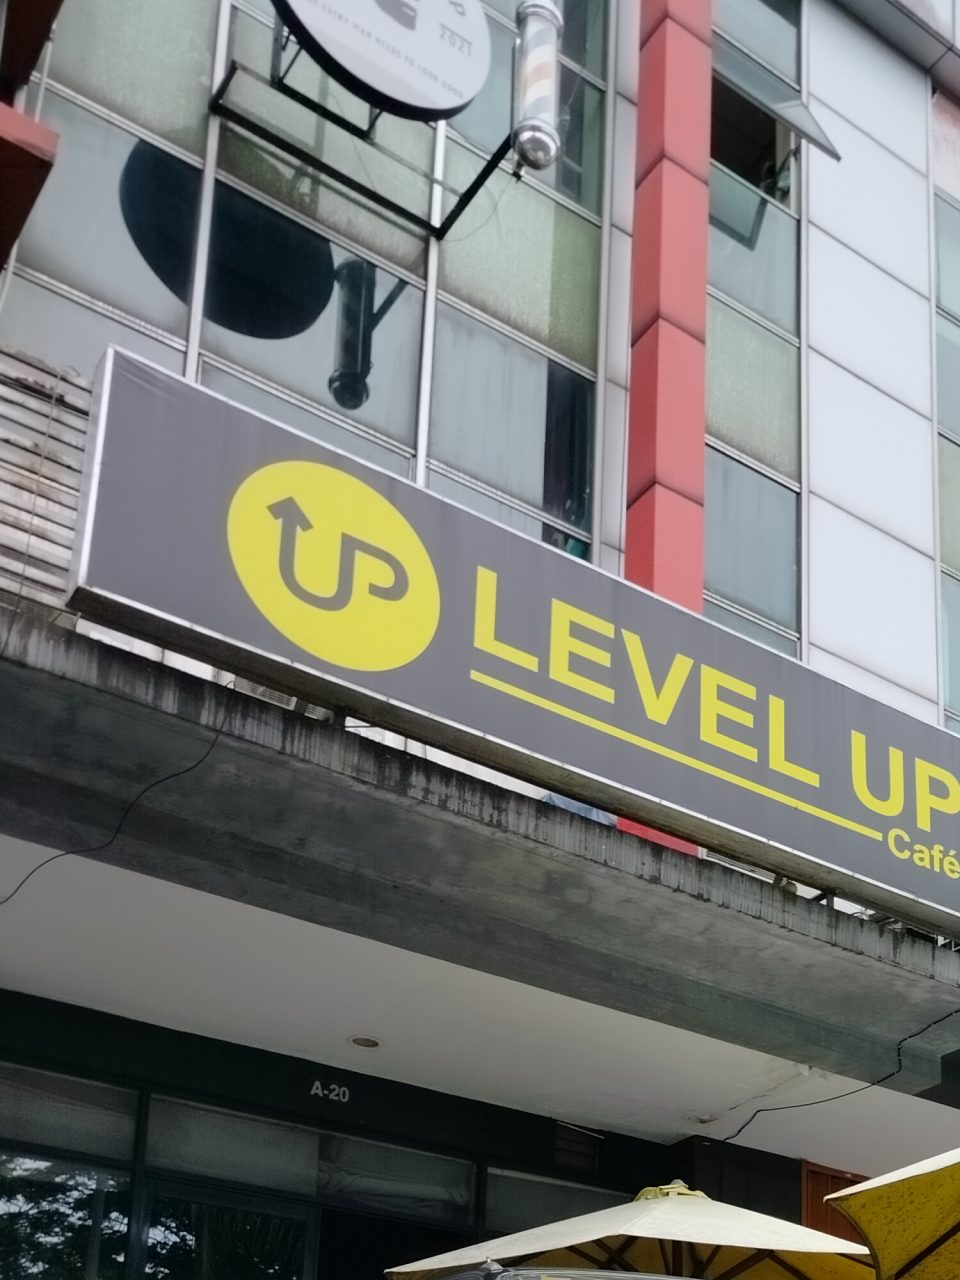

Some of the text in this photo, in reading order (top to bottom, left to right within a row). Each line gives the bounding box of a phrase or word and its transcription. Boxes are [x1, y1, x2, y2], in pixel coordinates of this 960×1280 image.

[473, 565, 820, 789] LEVEL
[887, 828, 960, 880] Café
[310, 1080, 350, 1103] A-20
